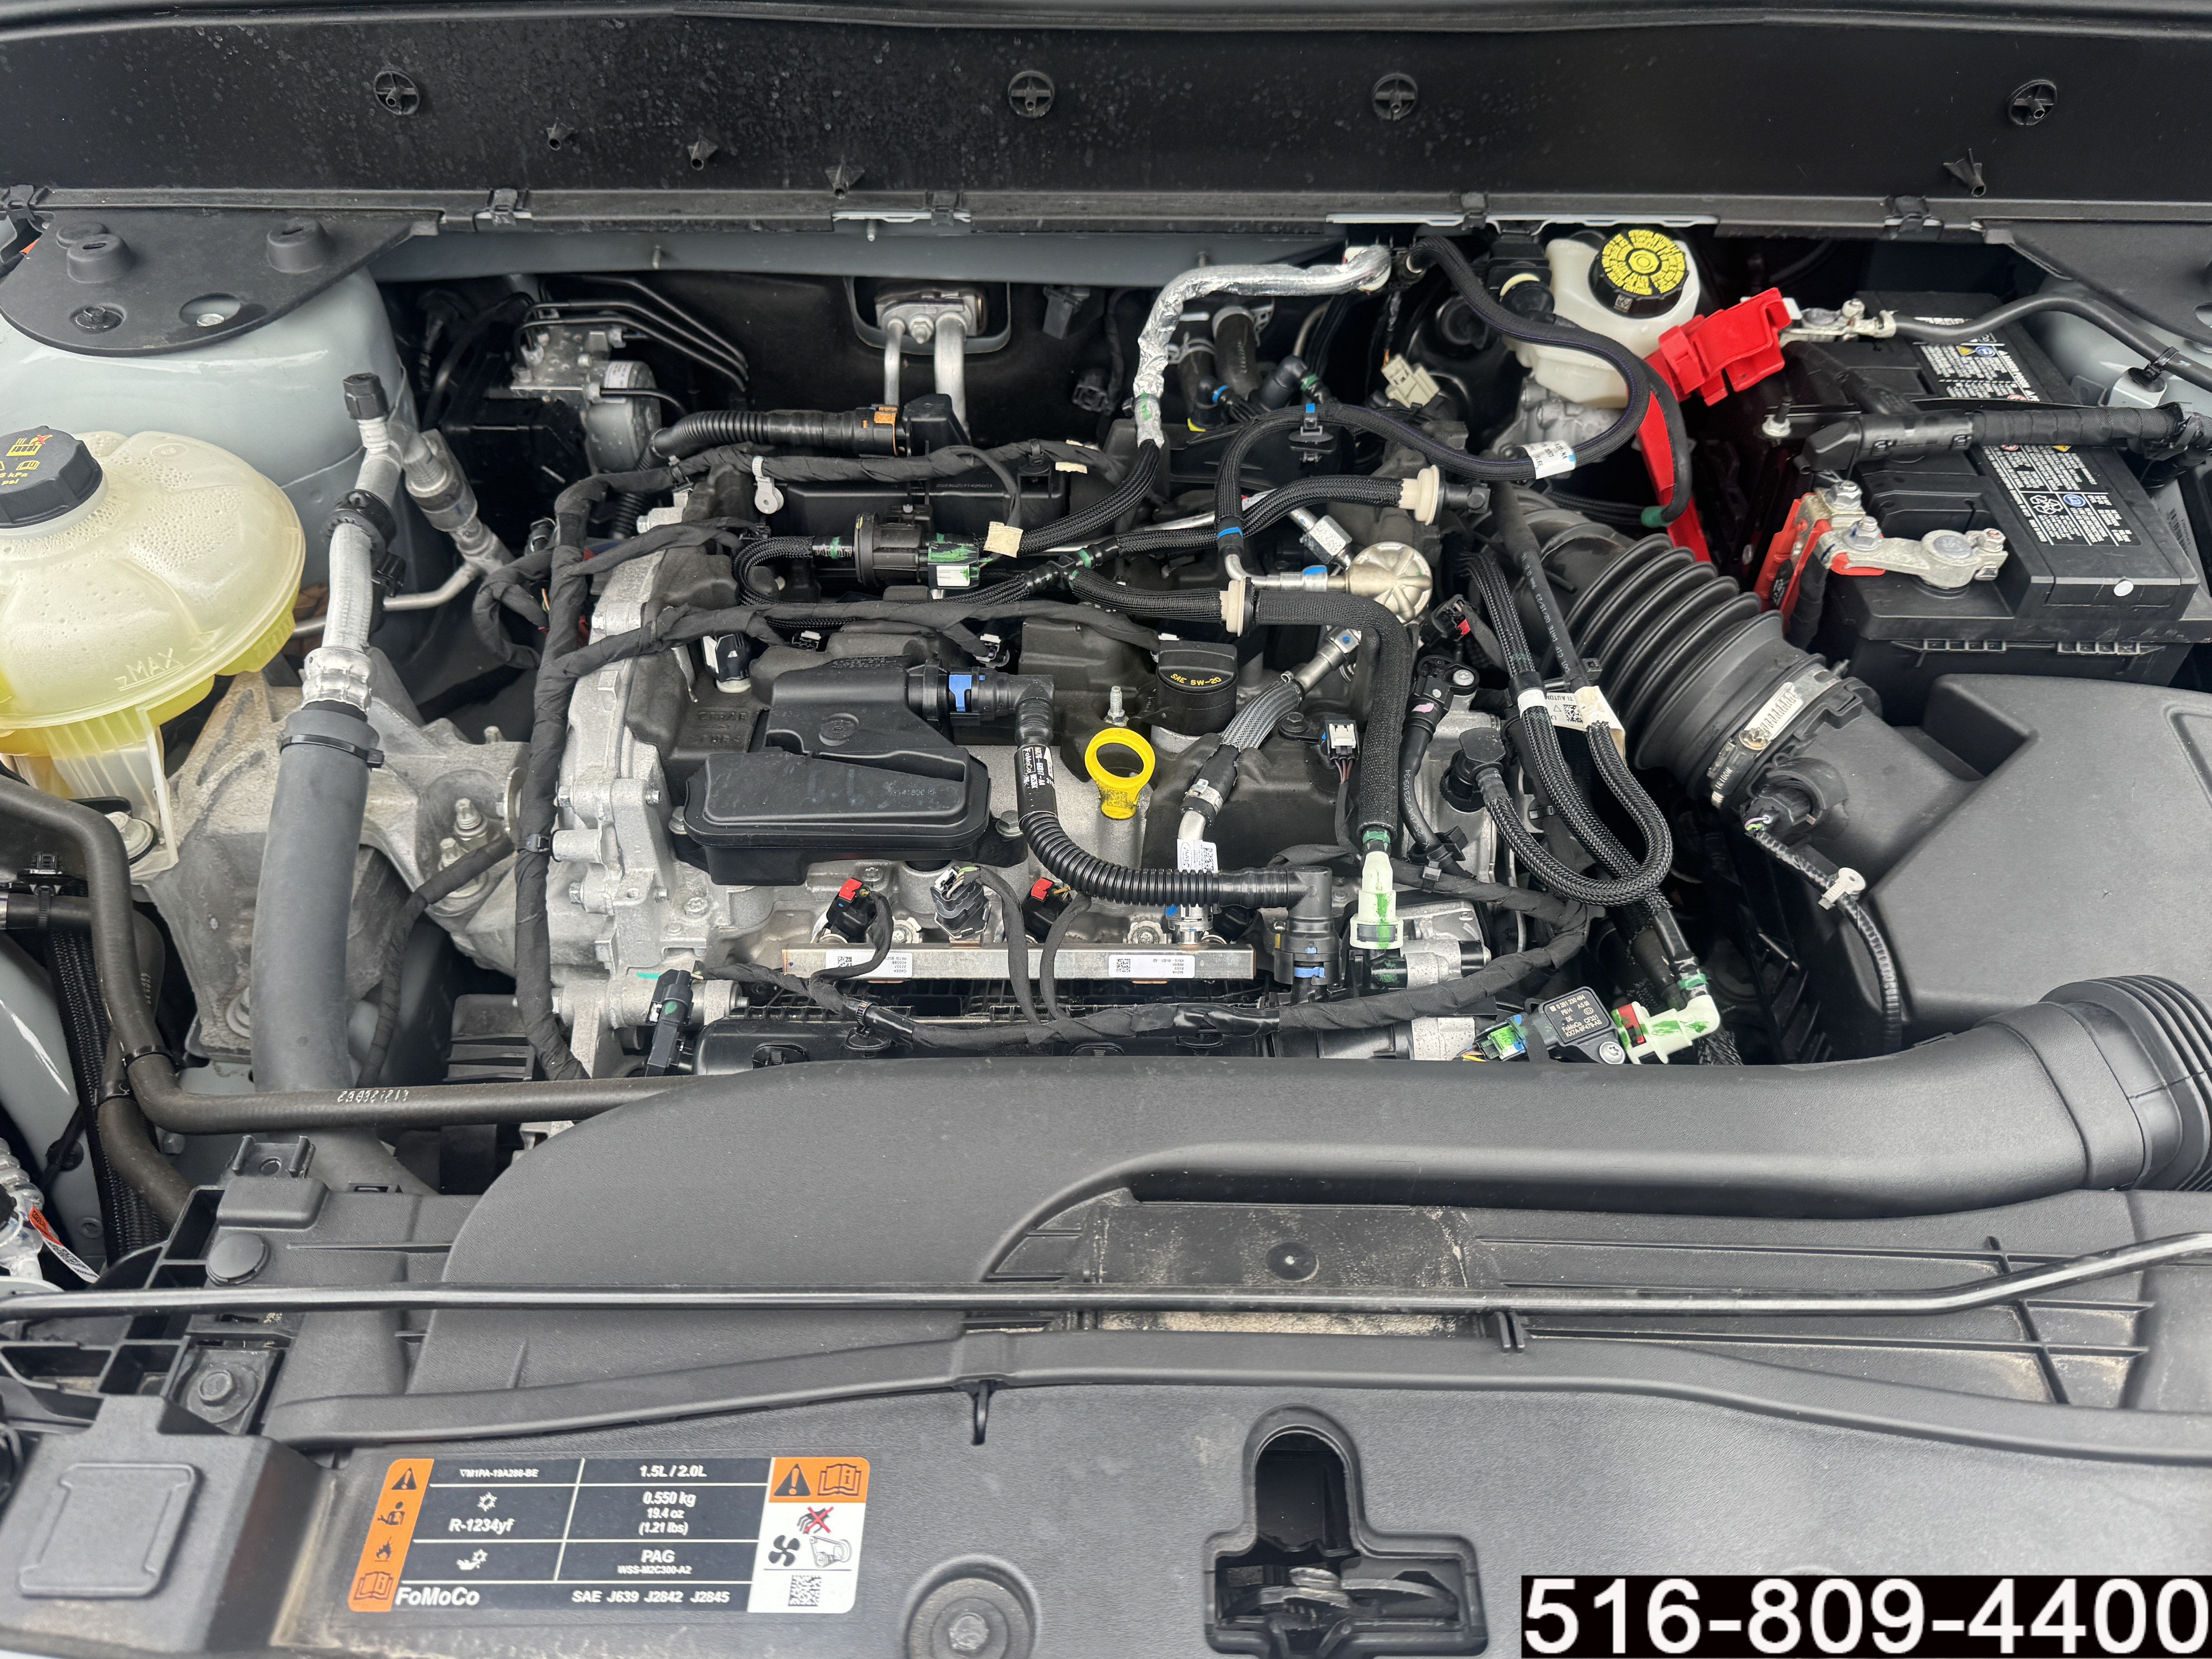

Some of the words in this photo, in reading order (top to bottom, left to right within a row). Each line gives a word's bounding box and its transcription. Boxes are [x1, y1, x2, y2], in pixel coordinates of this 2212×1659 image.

[814, 548, 852, 557] AUTOOTIVE
[1547, 625, 1559, 642] DATE
[126, 647, 184, 682] MAX
[1170, 673, 1187, 684] SAE
[1190, 677, 1222, 686] 5W-20
[1024, 749, 1033, 773] FoMoCo
[1561, 1020, 1582, 1033] FoMoCo
[640, 1465, 668, 1477] 1.5L
[669, 1465, 677, 1477] /
[677, 1465, 708, 1477] 2.0L
[642, 1491, 678, 1504] 0.550
[679, 1491, 697, 1508] kg
[647, 1507, 670, 1519] 19.4
[670, 1510, 685, 1519] oz
[448, 1518, 516, 1535] R-1234yf
[638, 1522, 666, 1536] (1.21
[666, 1522, 689, 1536] lbs)
[640, 1549, 676, 1563] PAG
[617, 1565, 692, 1575] WSS-M2C300-A2
[395, 1587, 480, 1606] FoMoCo
[571, 1590, 602, 1603] SAE
[606, 1590, 640, 1603] J639
[644, 1590, 684, 1603] J2842
[690, 1590, 730, 1603] J2845
